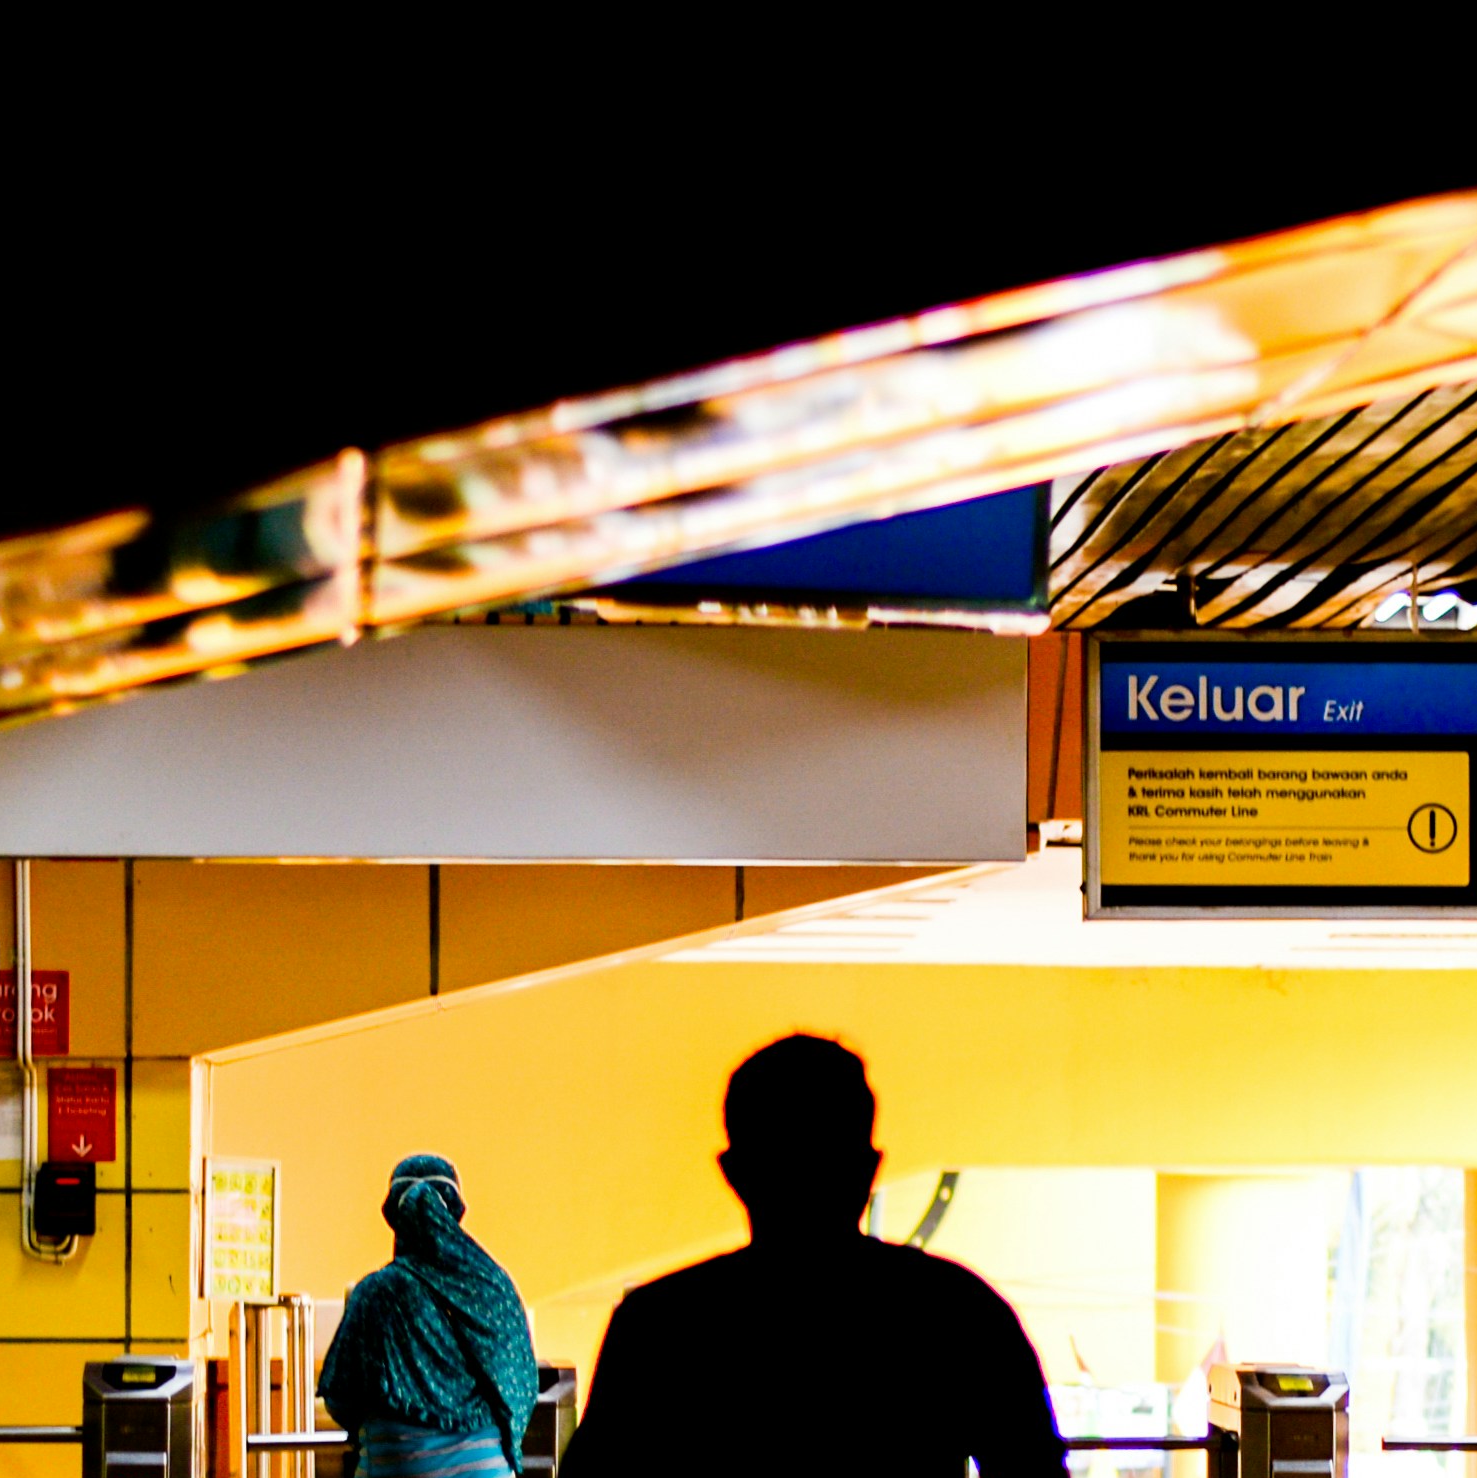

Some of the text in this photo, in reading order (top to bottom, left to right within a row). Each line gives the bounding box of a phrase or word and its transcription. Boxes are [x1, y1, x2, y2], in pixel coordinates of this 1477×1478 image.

[1128, 675, 1364, 722] Keluar Exit
[1128, 767, 1408, 783] Periksalah kembali barang bawaan anda
[1128, 786, 1366, 801] & terima kasih telah menggunakan
[1128, 805, 1259, 817] KRL Commuter Line
[1128, 837, 1162, 846] Please
[1165, 837, 1196, 846] check
[1200, 839, 1222, 848] your
[1285, 837, 1319, 846] before
[1227, 852, 1282, 862] Commuter
